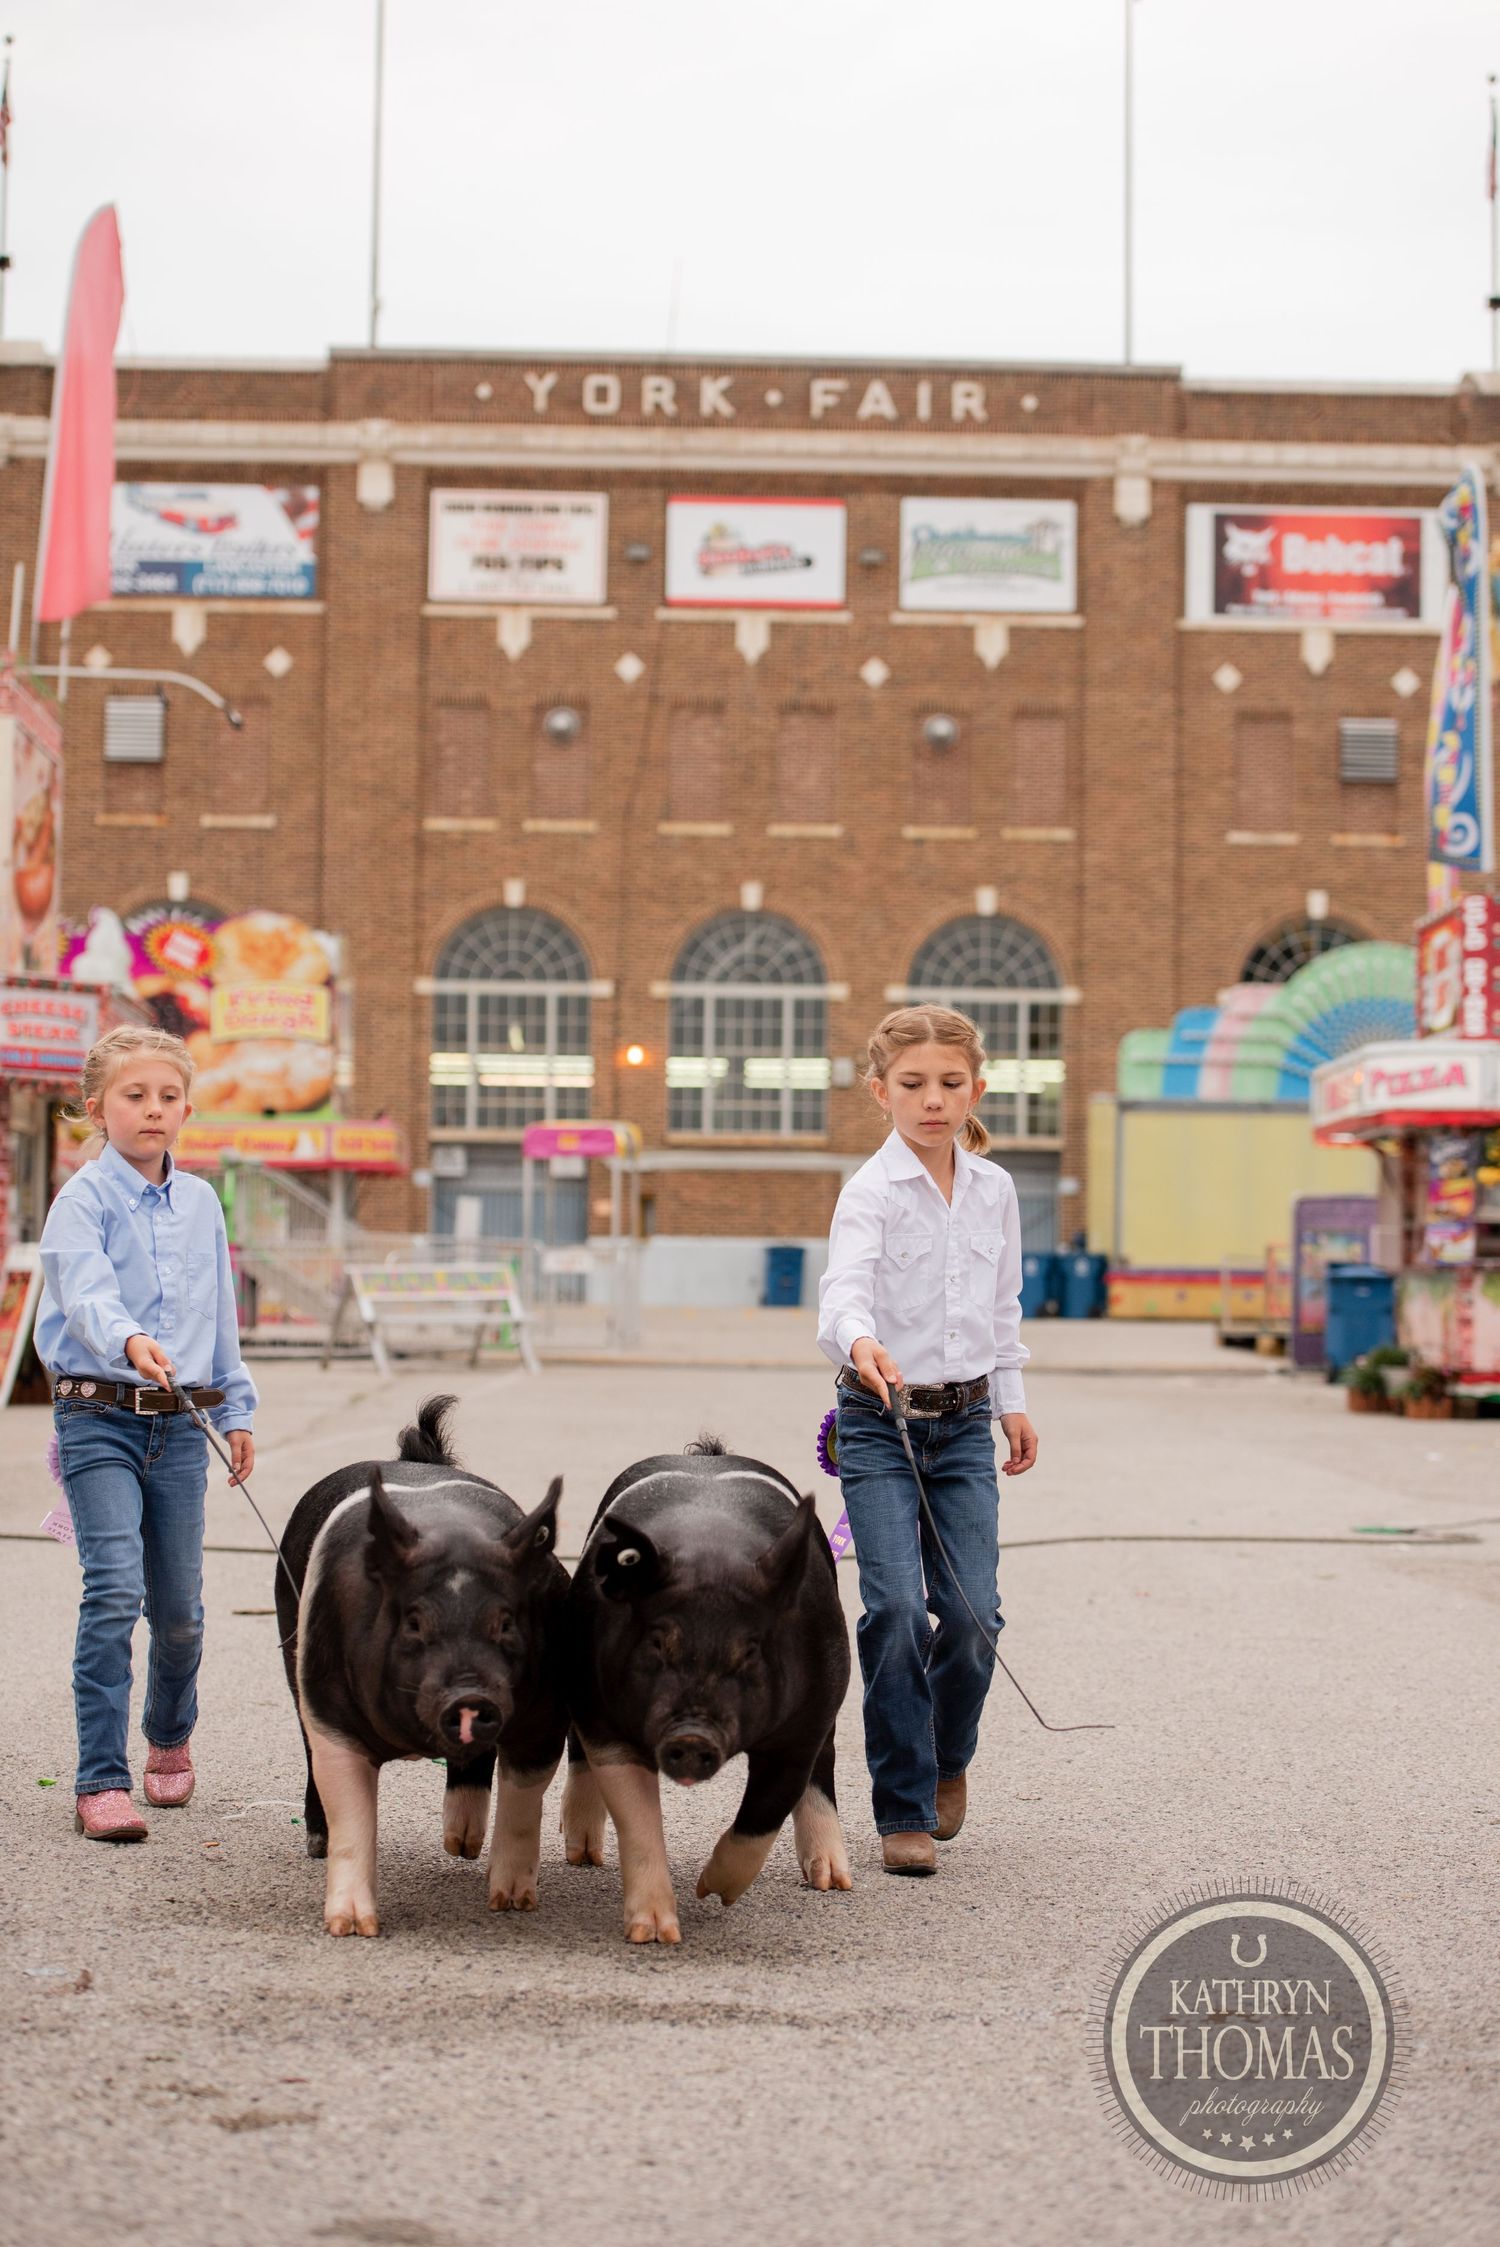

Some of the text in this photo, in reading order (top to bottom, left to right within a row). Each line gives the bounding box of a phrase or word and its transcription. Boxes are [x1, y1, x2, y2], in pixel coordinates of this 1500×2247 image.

[524, 371, 989, 422] YORK FAIR
[1281, 532, 1405, 577] Bobcat
[1, 999, 86, 1024] CHEESE
[8, 1021, 79, 1041] STEAK
[832, 1533, 847, 1547] YORK
